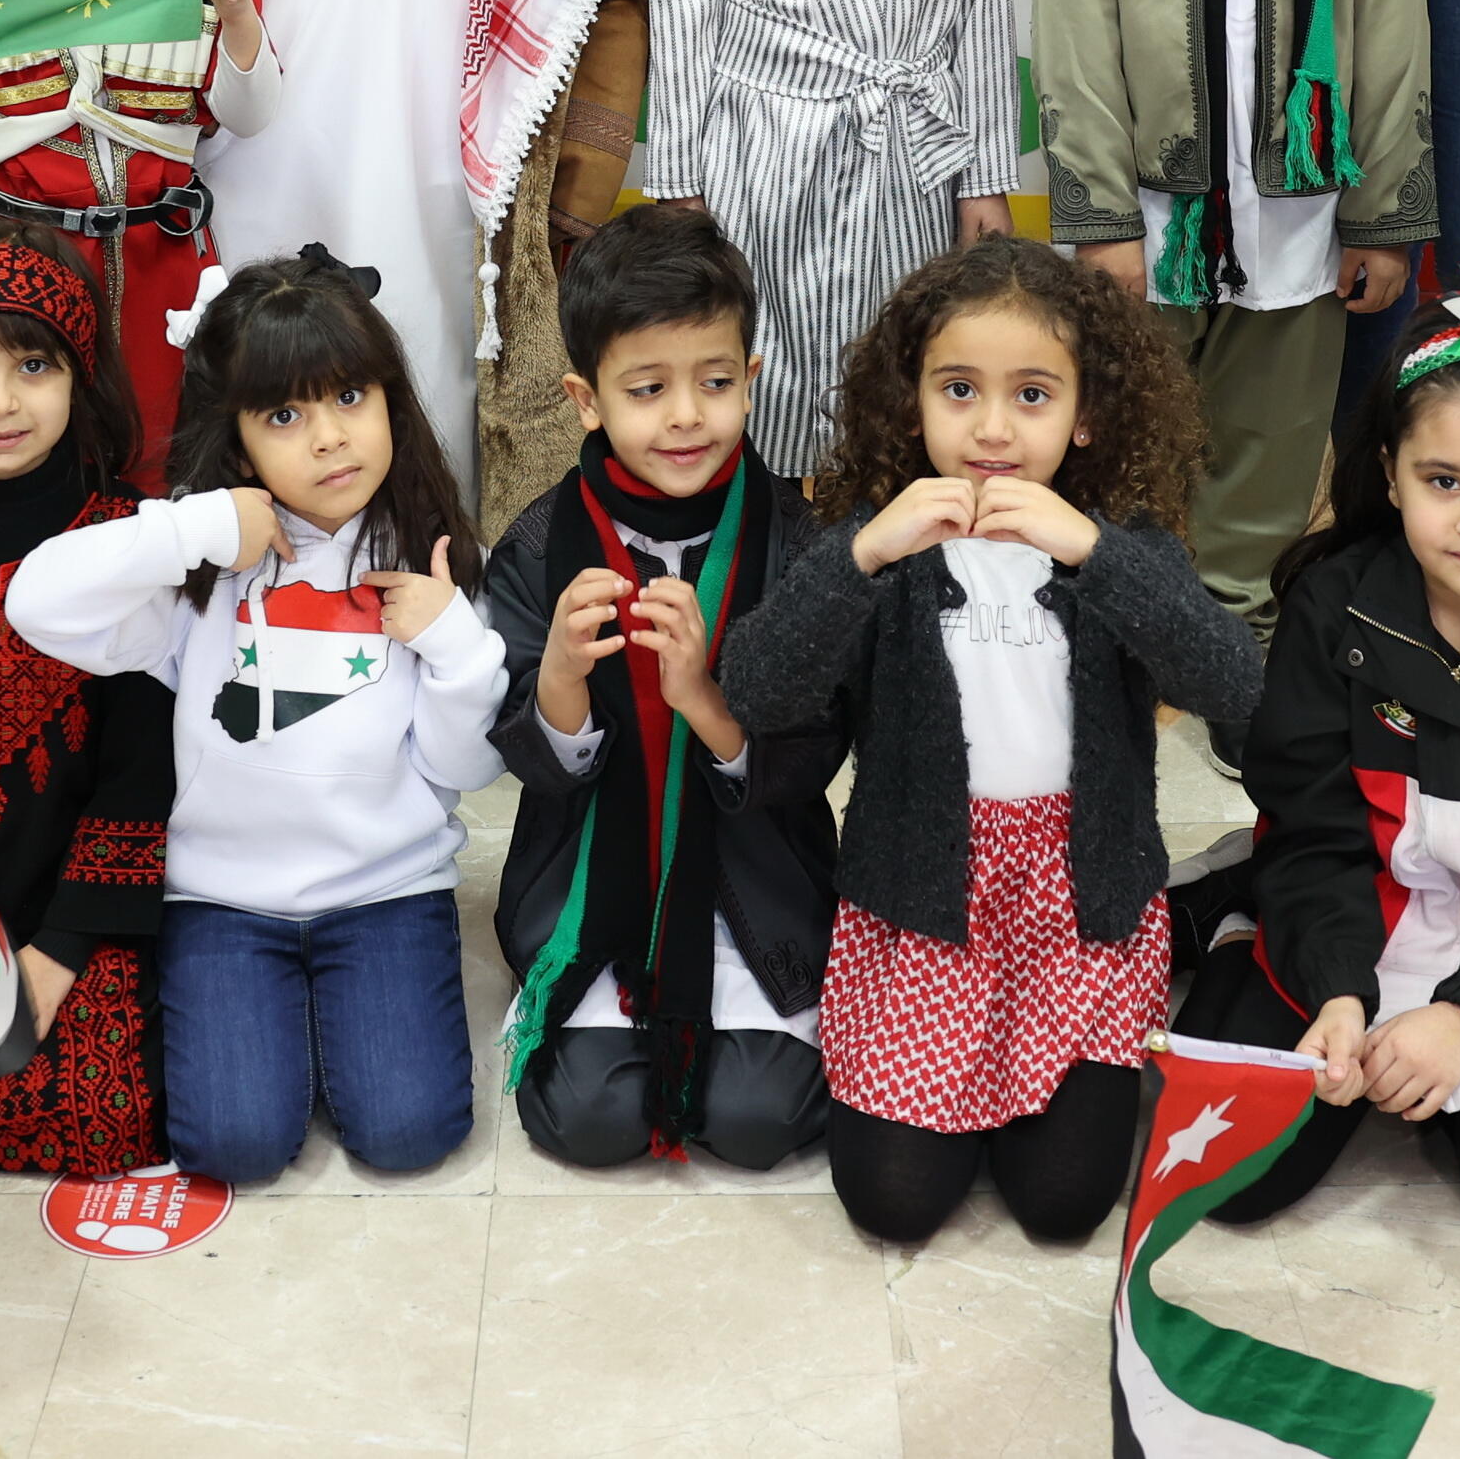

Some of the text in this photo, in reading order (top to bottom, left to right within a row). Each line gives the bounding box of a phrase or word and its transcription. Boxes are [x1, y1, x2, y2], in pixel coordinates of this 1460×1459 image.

[112, 1183, 138, 1220] HERE
[139, 1185, 164, 1219] WAIT
[162, 1177, 189, 1229] PLEASE
